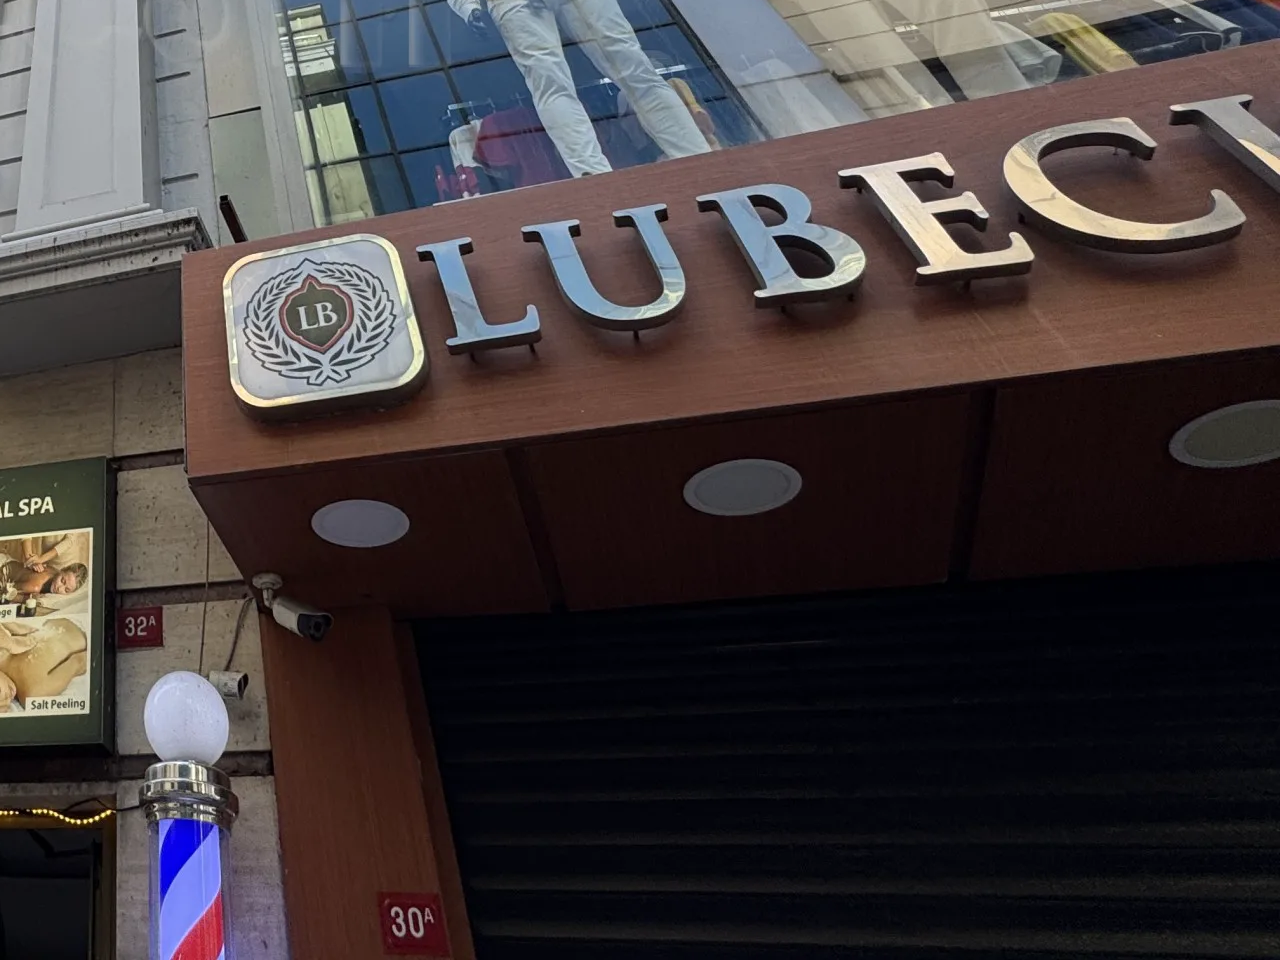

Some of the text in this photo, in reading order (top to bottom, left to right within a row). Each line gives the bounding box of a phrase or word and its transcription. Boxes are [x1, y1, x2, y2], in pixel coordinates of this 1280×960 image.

[298, 301, 338, 331] LB
[17, 496, 55, 517] SPA
[125, 615, 156, 637] 32A
[30, 698, 86, 711] Salt Peeling
[390, 906, 434, 939] 30A
